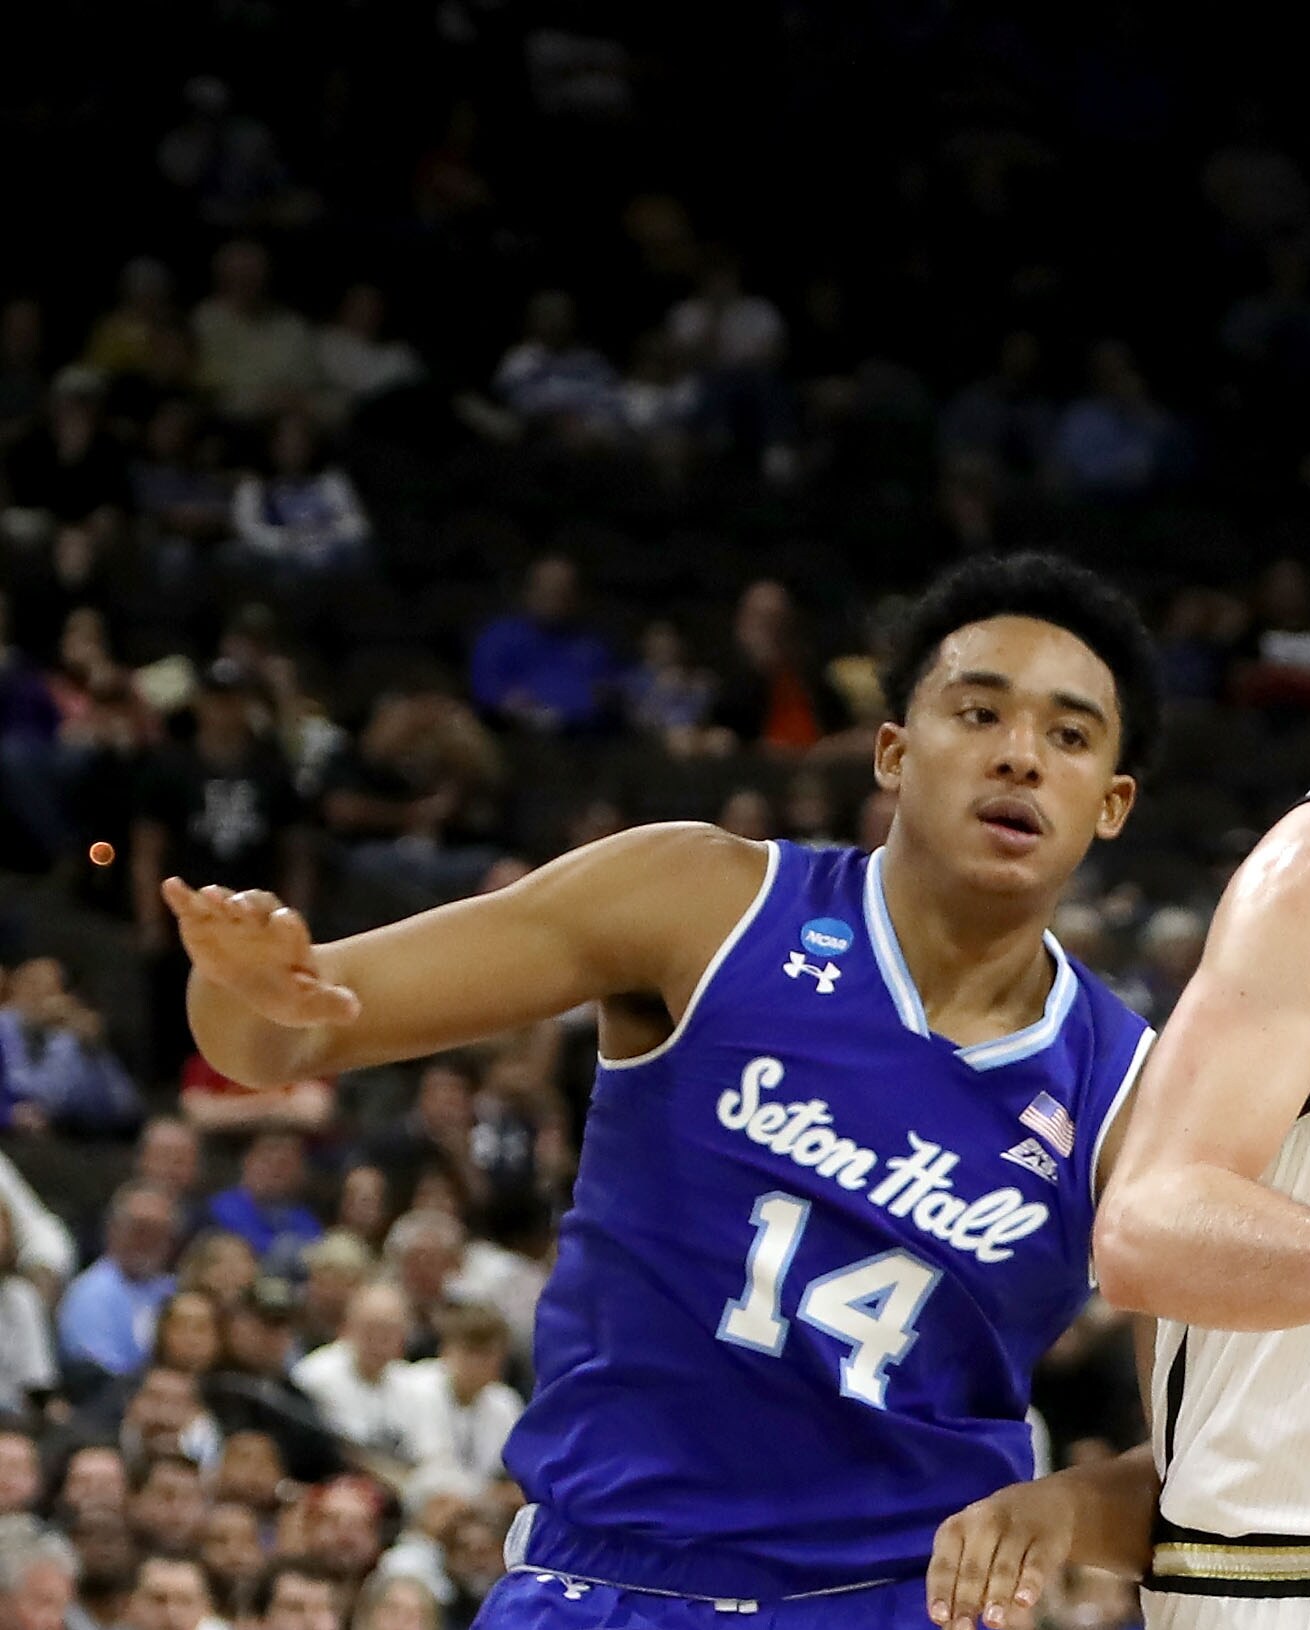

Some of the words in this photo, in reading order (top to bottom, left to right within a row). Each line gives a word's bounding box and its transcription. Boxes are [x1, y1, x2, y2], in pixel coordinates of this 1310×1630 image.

[716, 1056, 876, 1191] Seton
[866, 1130, 1050, 1264] Hall
[714, 1189, 946, 1411] 14
